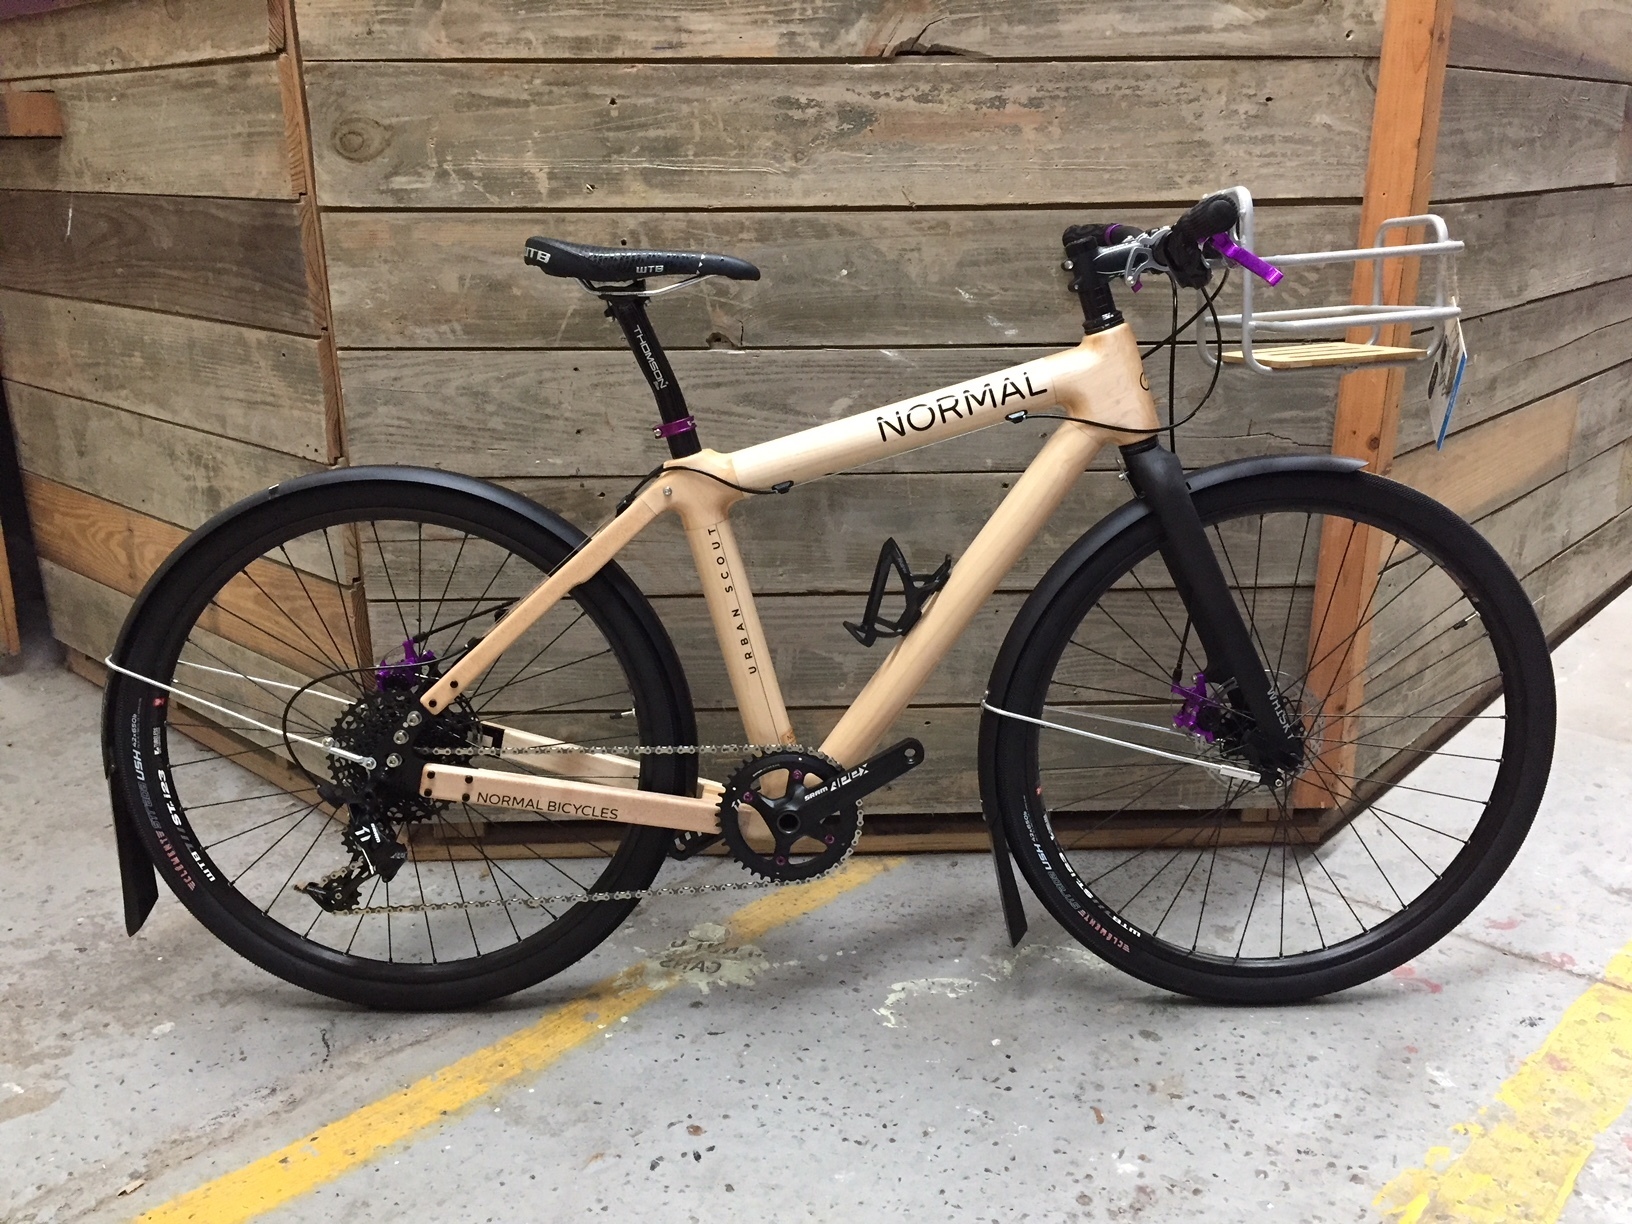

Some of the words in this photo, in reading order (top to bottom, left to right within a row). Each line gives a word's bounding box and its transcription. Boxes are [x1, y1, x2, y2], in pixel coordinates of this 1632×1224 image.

[636, 265, 664, 274] WTB
[634, 324, 668, 389] THOMSON
[876, 371, 1048, 442] NORMAL
[707, 528, 733, 593] SCOUT
[731, 608, 757, 675] URBAN
[1267, 687, 1295, 740] WHISKY
[132, 749, 145, 781] USH
[477, 792, 543, 811] NORMAL
[547, 800, 619, 820] BICYCLES
[190, 851, 216, 882] WTB
[1034, 843, 1052, 870] USH
[1112, 915, 1141, 938] WTB
